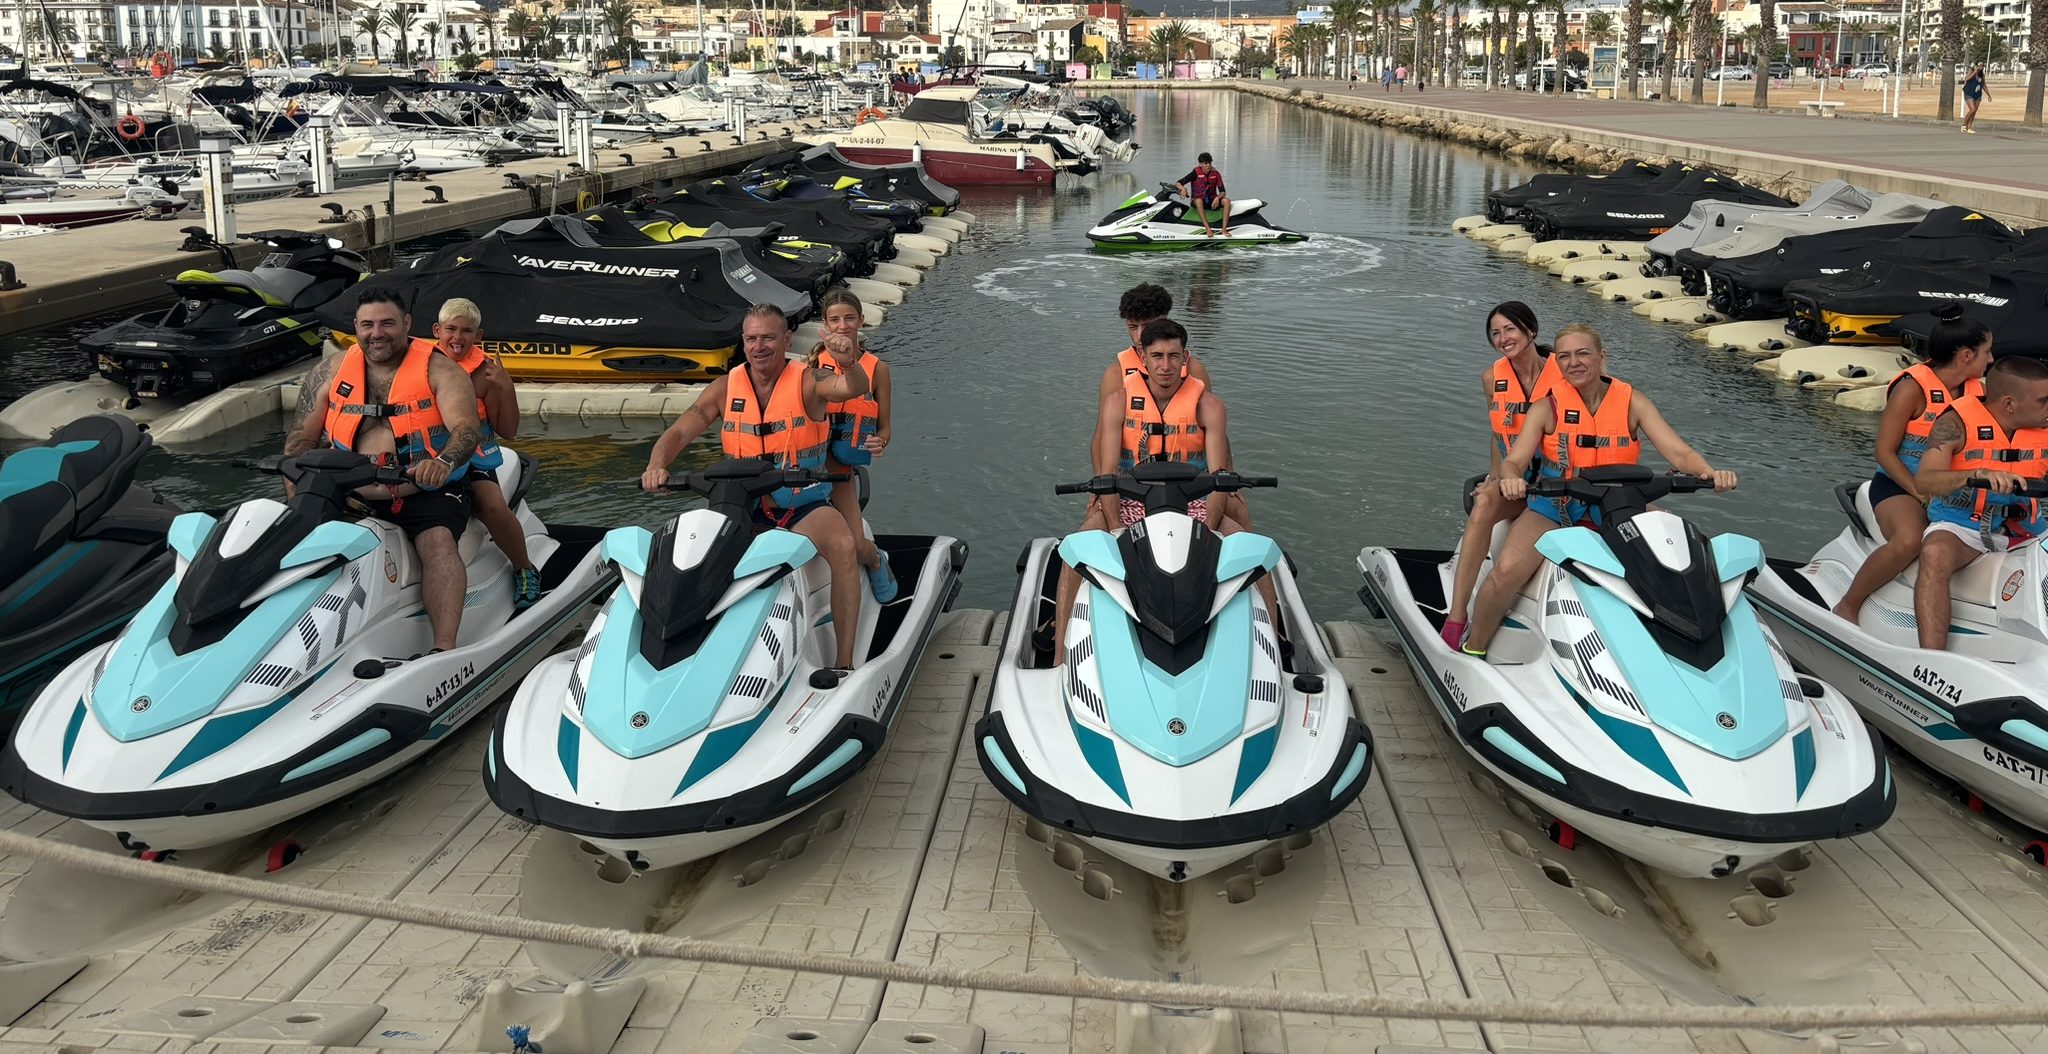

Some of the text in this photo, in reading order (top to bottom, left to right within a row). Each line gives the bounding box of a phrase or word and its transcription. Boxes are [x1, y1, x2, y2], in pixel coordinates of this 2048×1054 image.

[979, 145, 1007, 153] MARINA
[263, 325, 277, 334] GTI
[472, 342, 572, 355] EA-DOO
[690, 532, 697, 540] 5
[1167, 530, 1174, 538] 4
[1666, 537, 1674, 545] 6
[1983, 746, 2048, 785] 6-AT-7/
